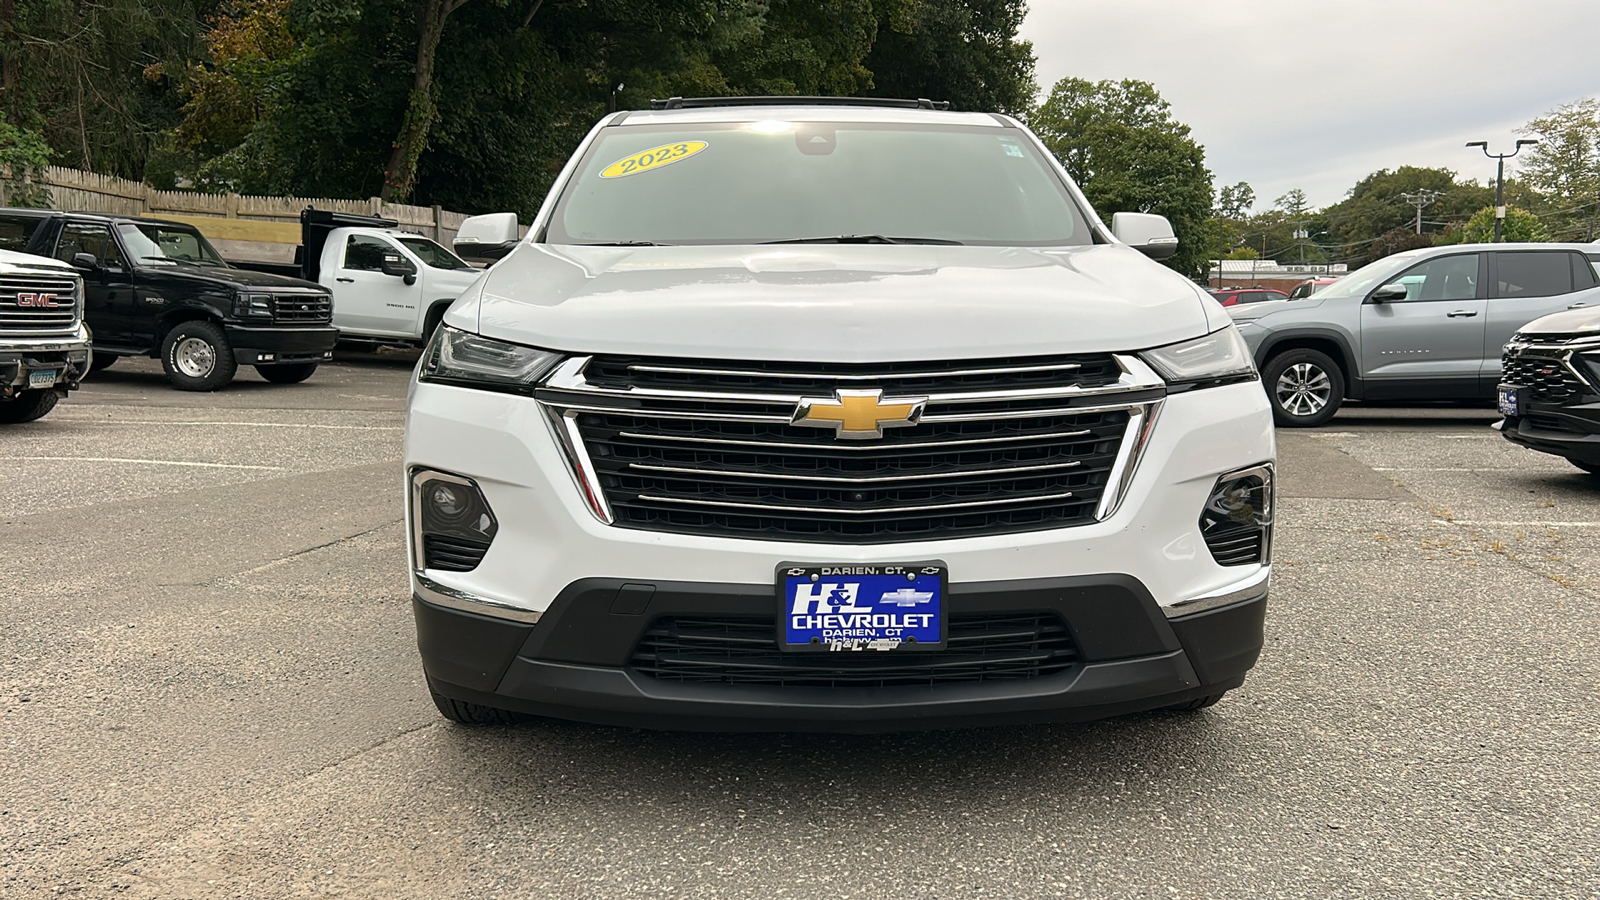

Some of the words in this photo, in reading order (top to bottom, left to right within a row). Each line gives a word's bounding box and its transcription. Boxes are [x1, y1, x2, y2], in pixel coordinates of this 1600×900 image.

[620, 143, 689, 174] 2023
[17, 292, 59, 308] GMC
[821, 567, 879, 576] DARIEN,
[885, 566, 906, 575] CT.
[791, 582, 873, 615] H&L
[792, 614, 934, 629] CHEVROLET
[822, 629, 880, 637] DARIEN,
[885, 628, 903, 636] CT
